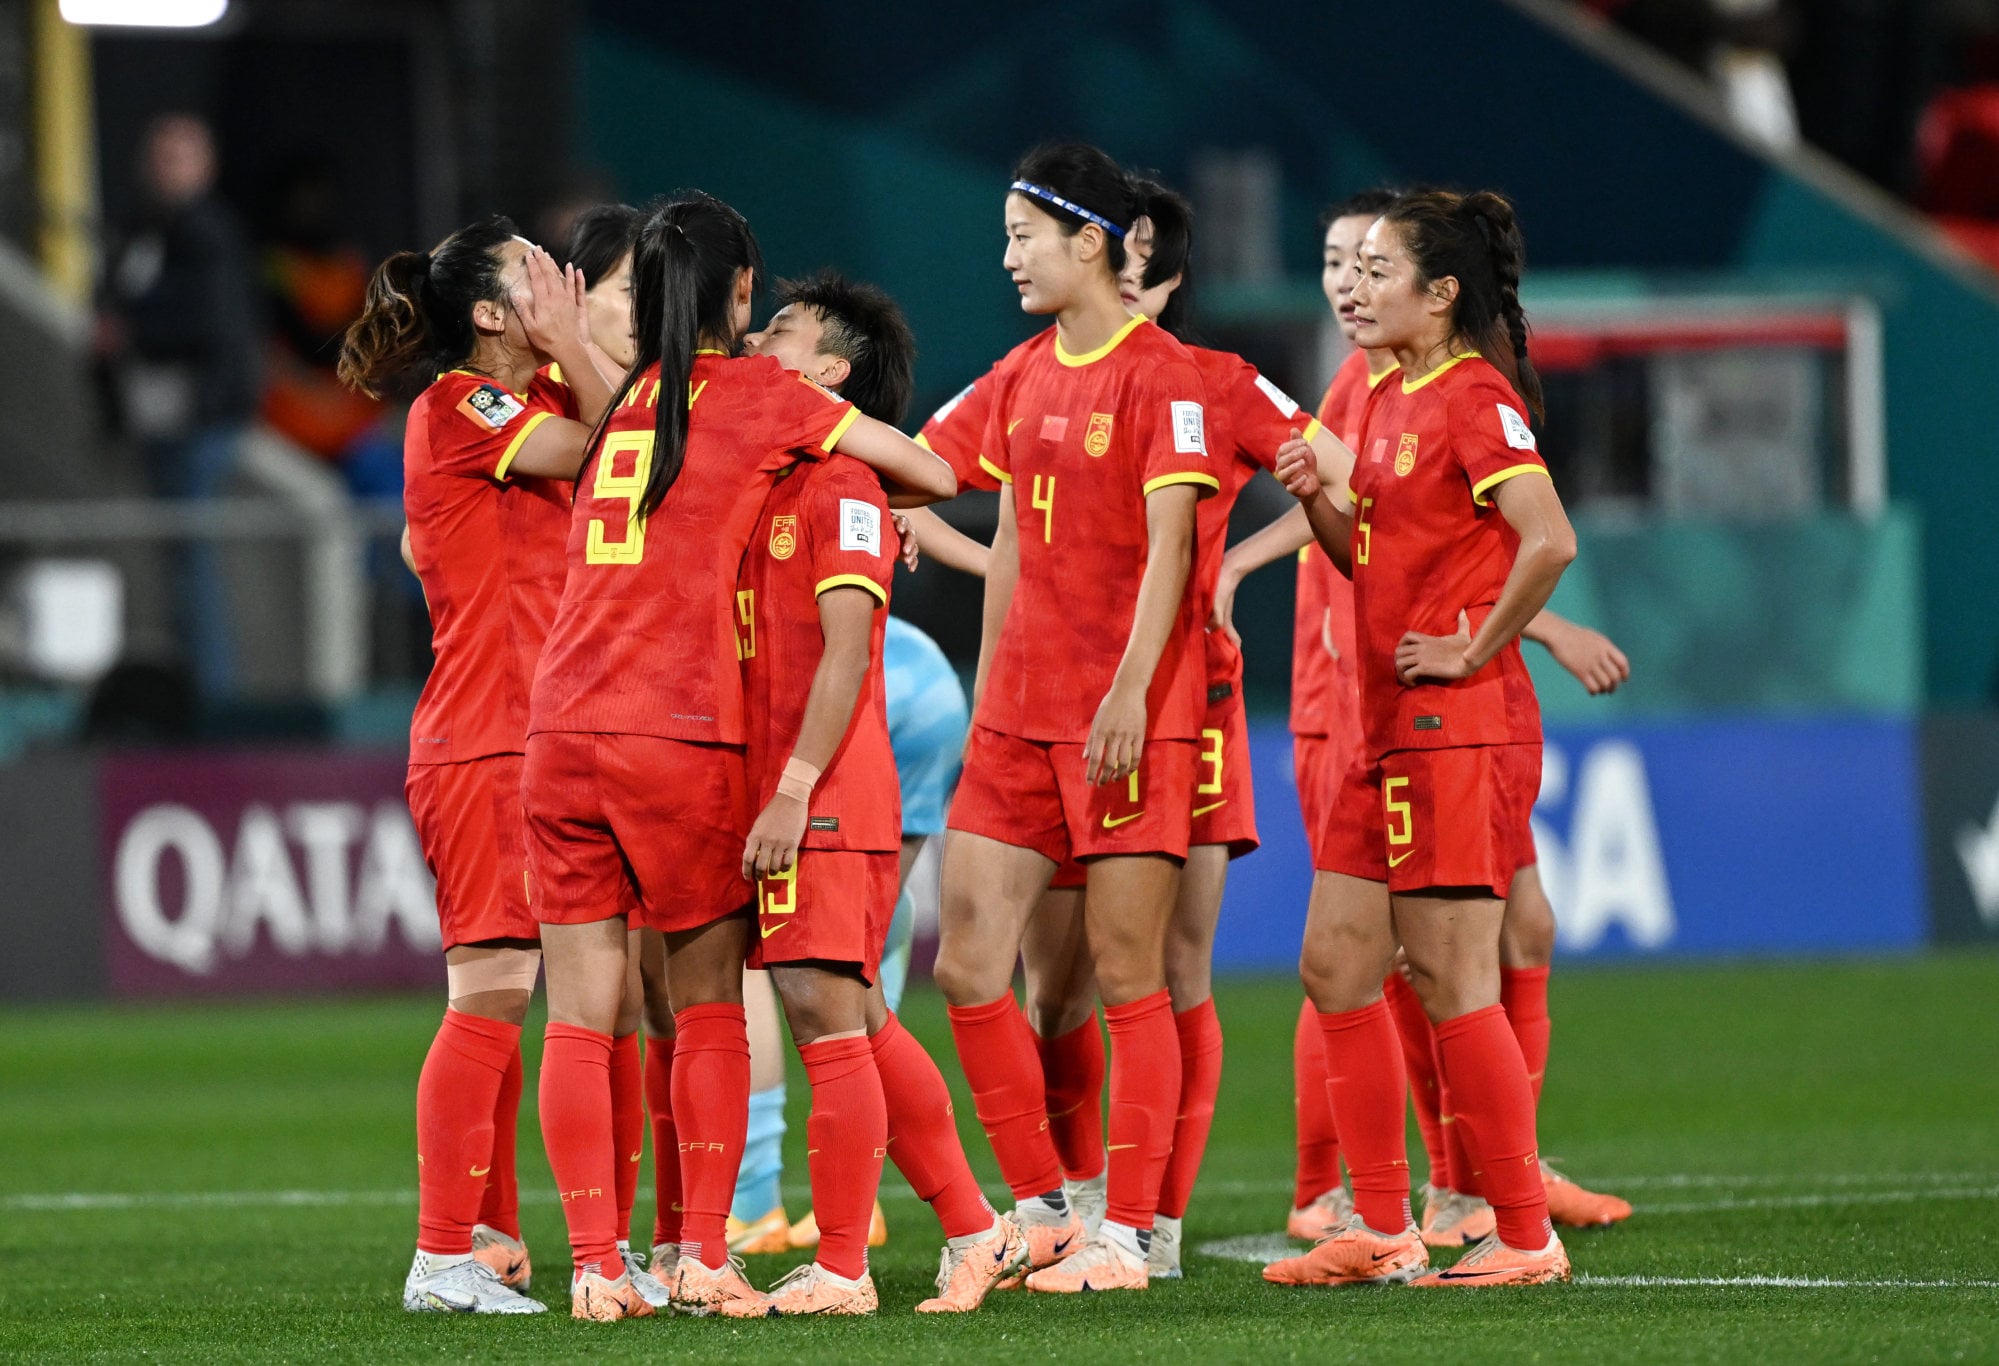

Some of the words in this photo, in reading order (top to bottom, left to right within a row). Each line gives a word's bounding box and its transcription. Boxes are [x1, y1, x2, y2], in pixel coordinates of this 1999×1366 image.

[586, 430, 656, 564] 9
[775, 518, 795, 527] CFA
[1032, 474, 1056, 544] 4
[1357, 498, 1373, 566] 5
[1386, 777, 1412, 845] 5
[114, 802, 442, 976] QATA
[678, 1142, 725, 1153] CFA
[560, 1188, 602, 1202] CFA
